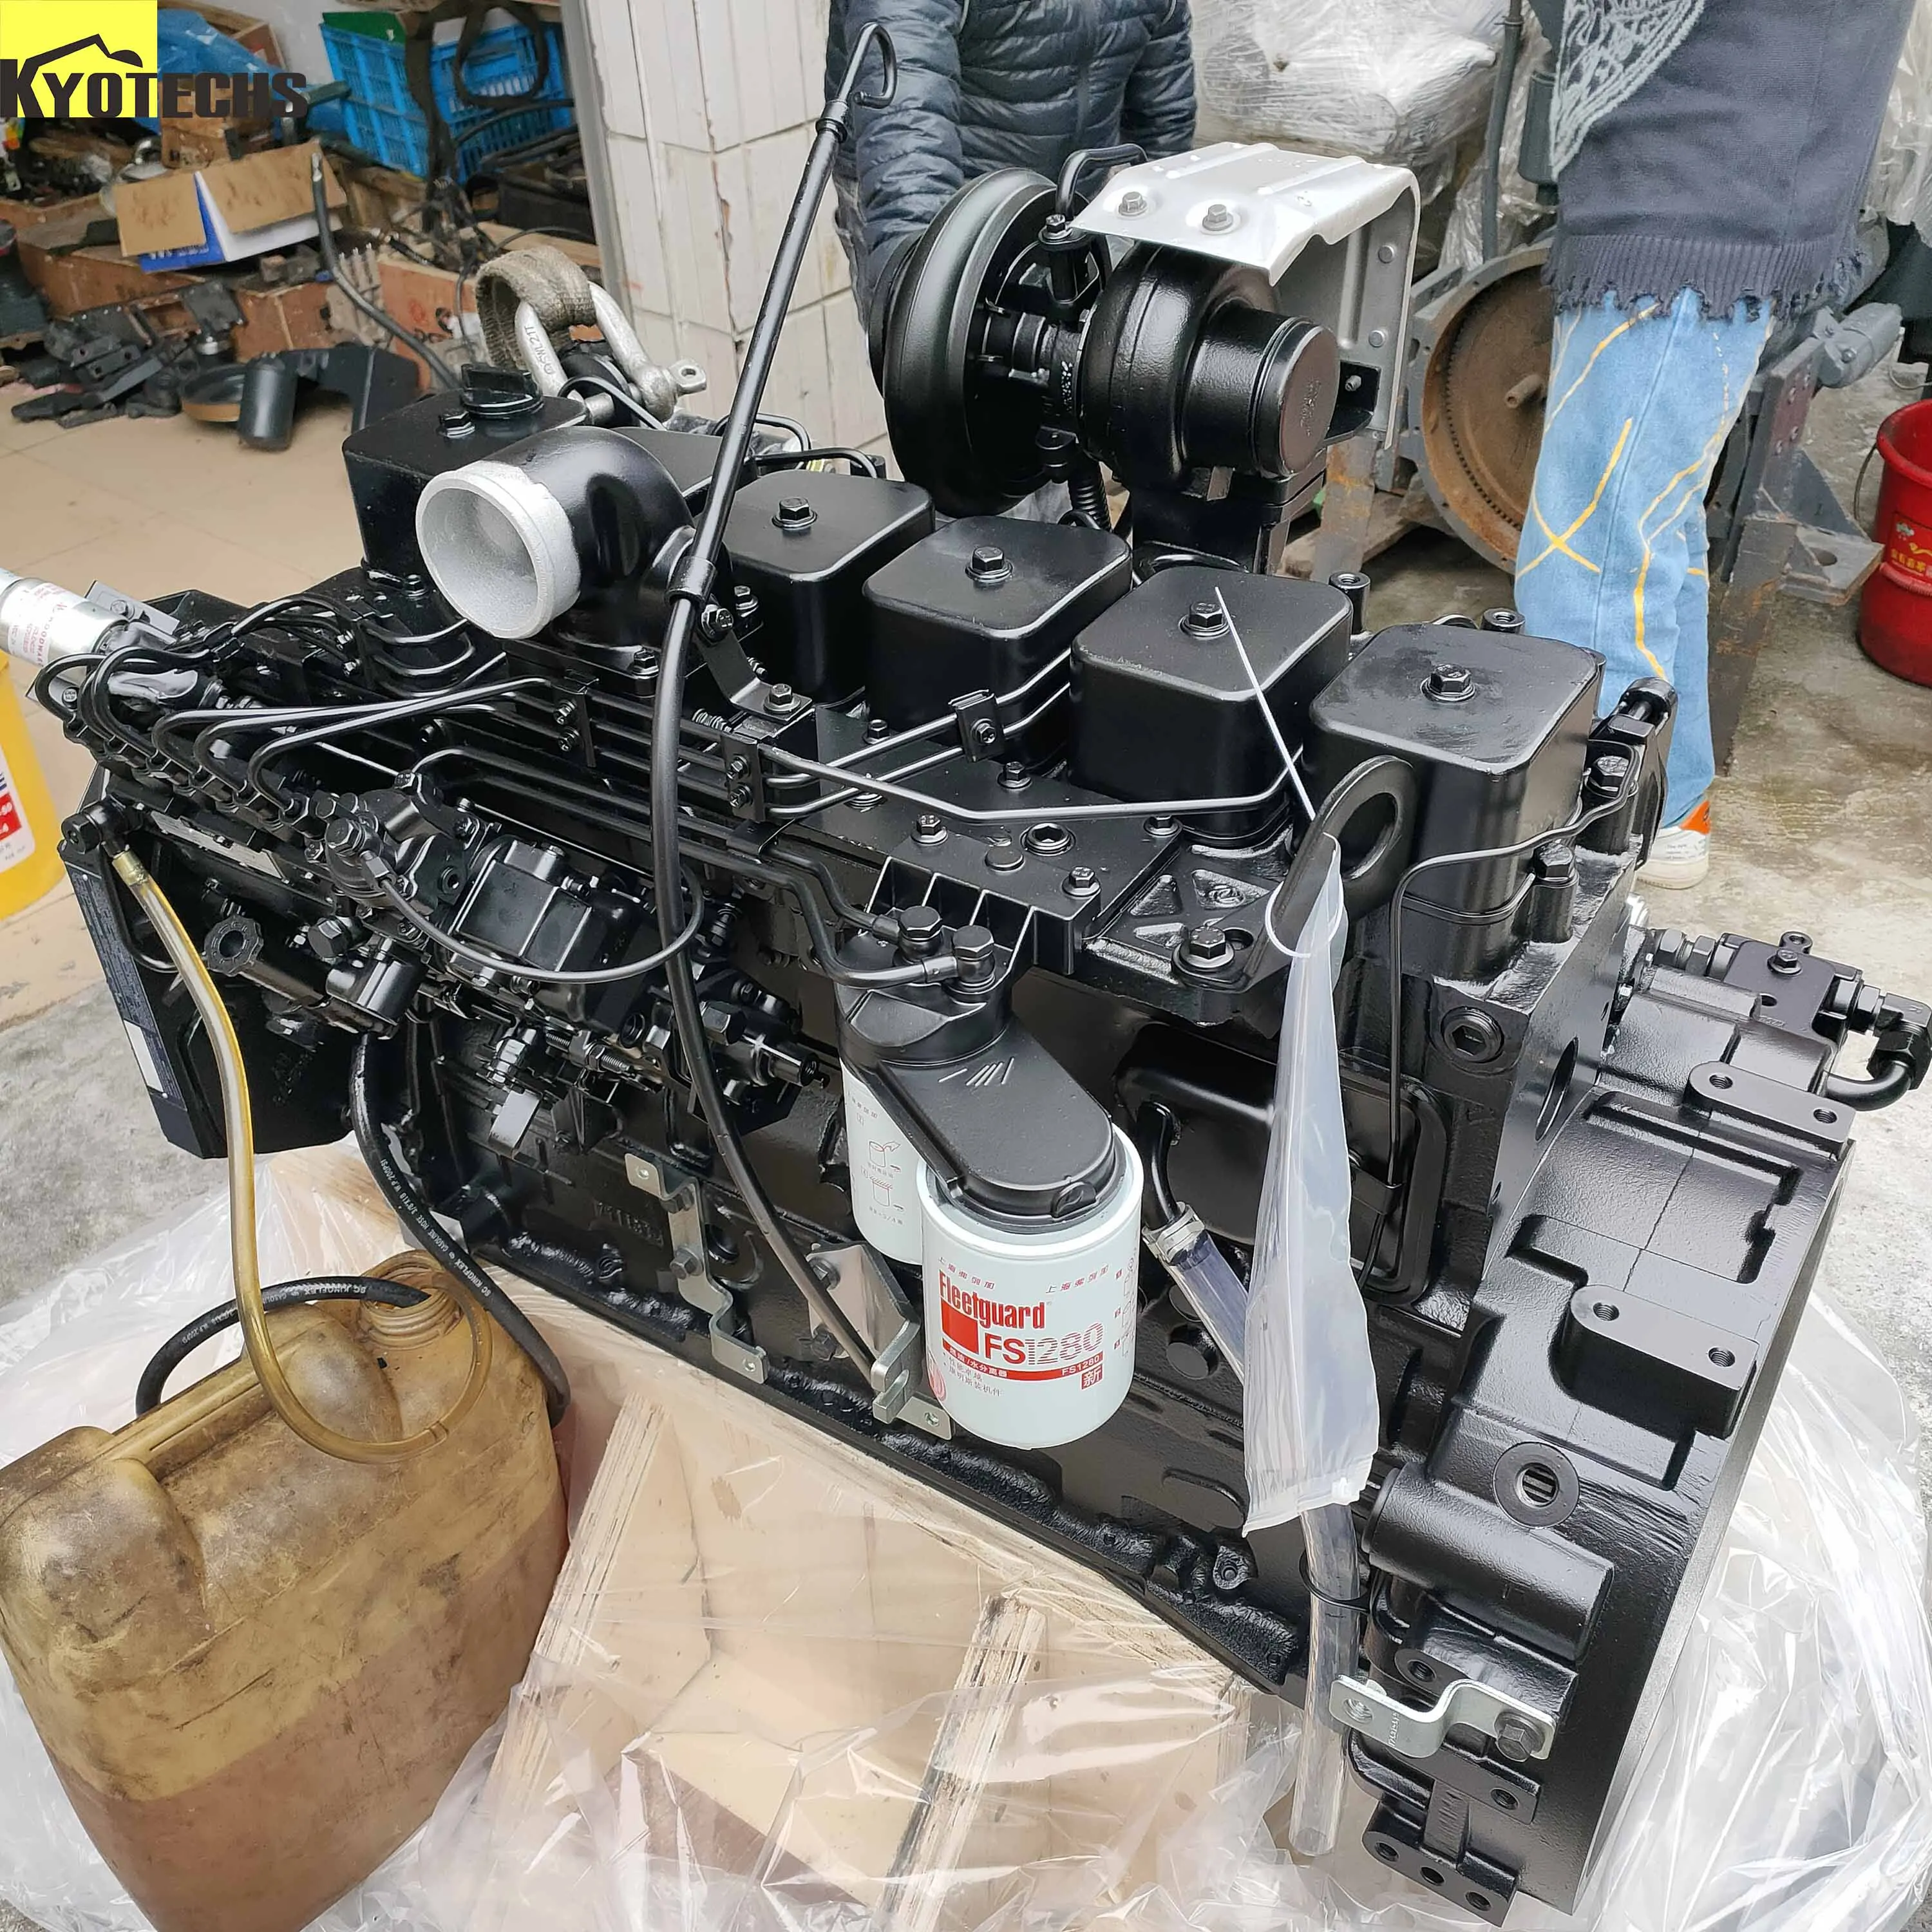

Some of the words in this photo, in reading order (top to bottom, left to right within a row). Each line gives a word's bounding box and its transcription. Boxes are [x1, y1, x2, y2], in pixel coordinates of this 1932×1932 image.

[939, 1269, 1046, 1329] Fleetguard
[985, 1322, 1104, 1365] FS1280
[1061, 1355, 1101, 1376] FS1280
[1083, 1365, 1103, 1387] 新
